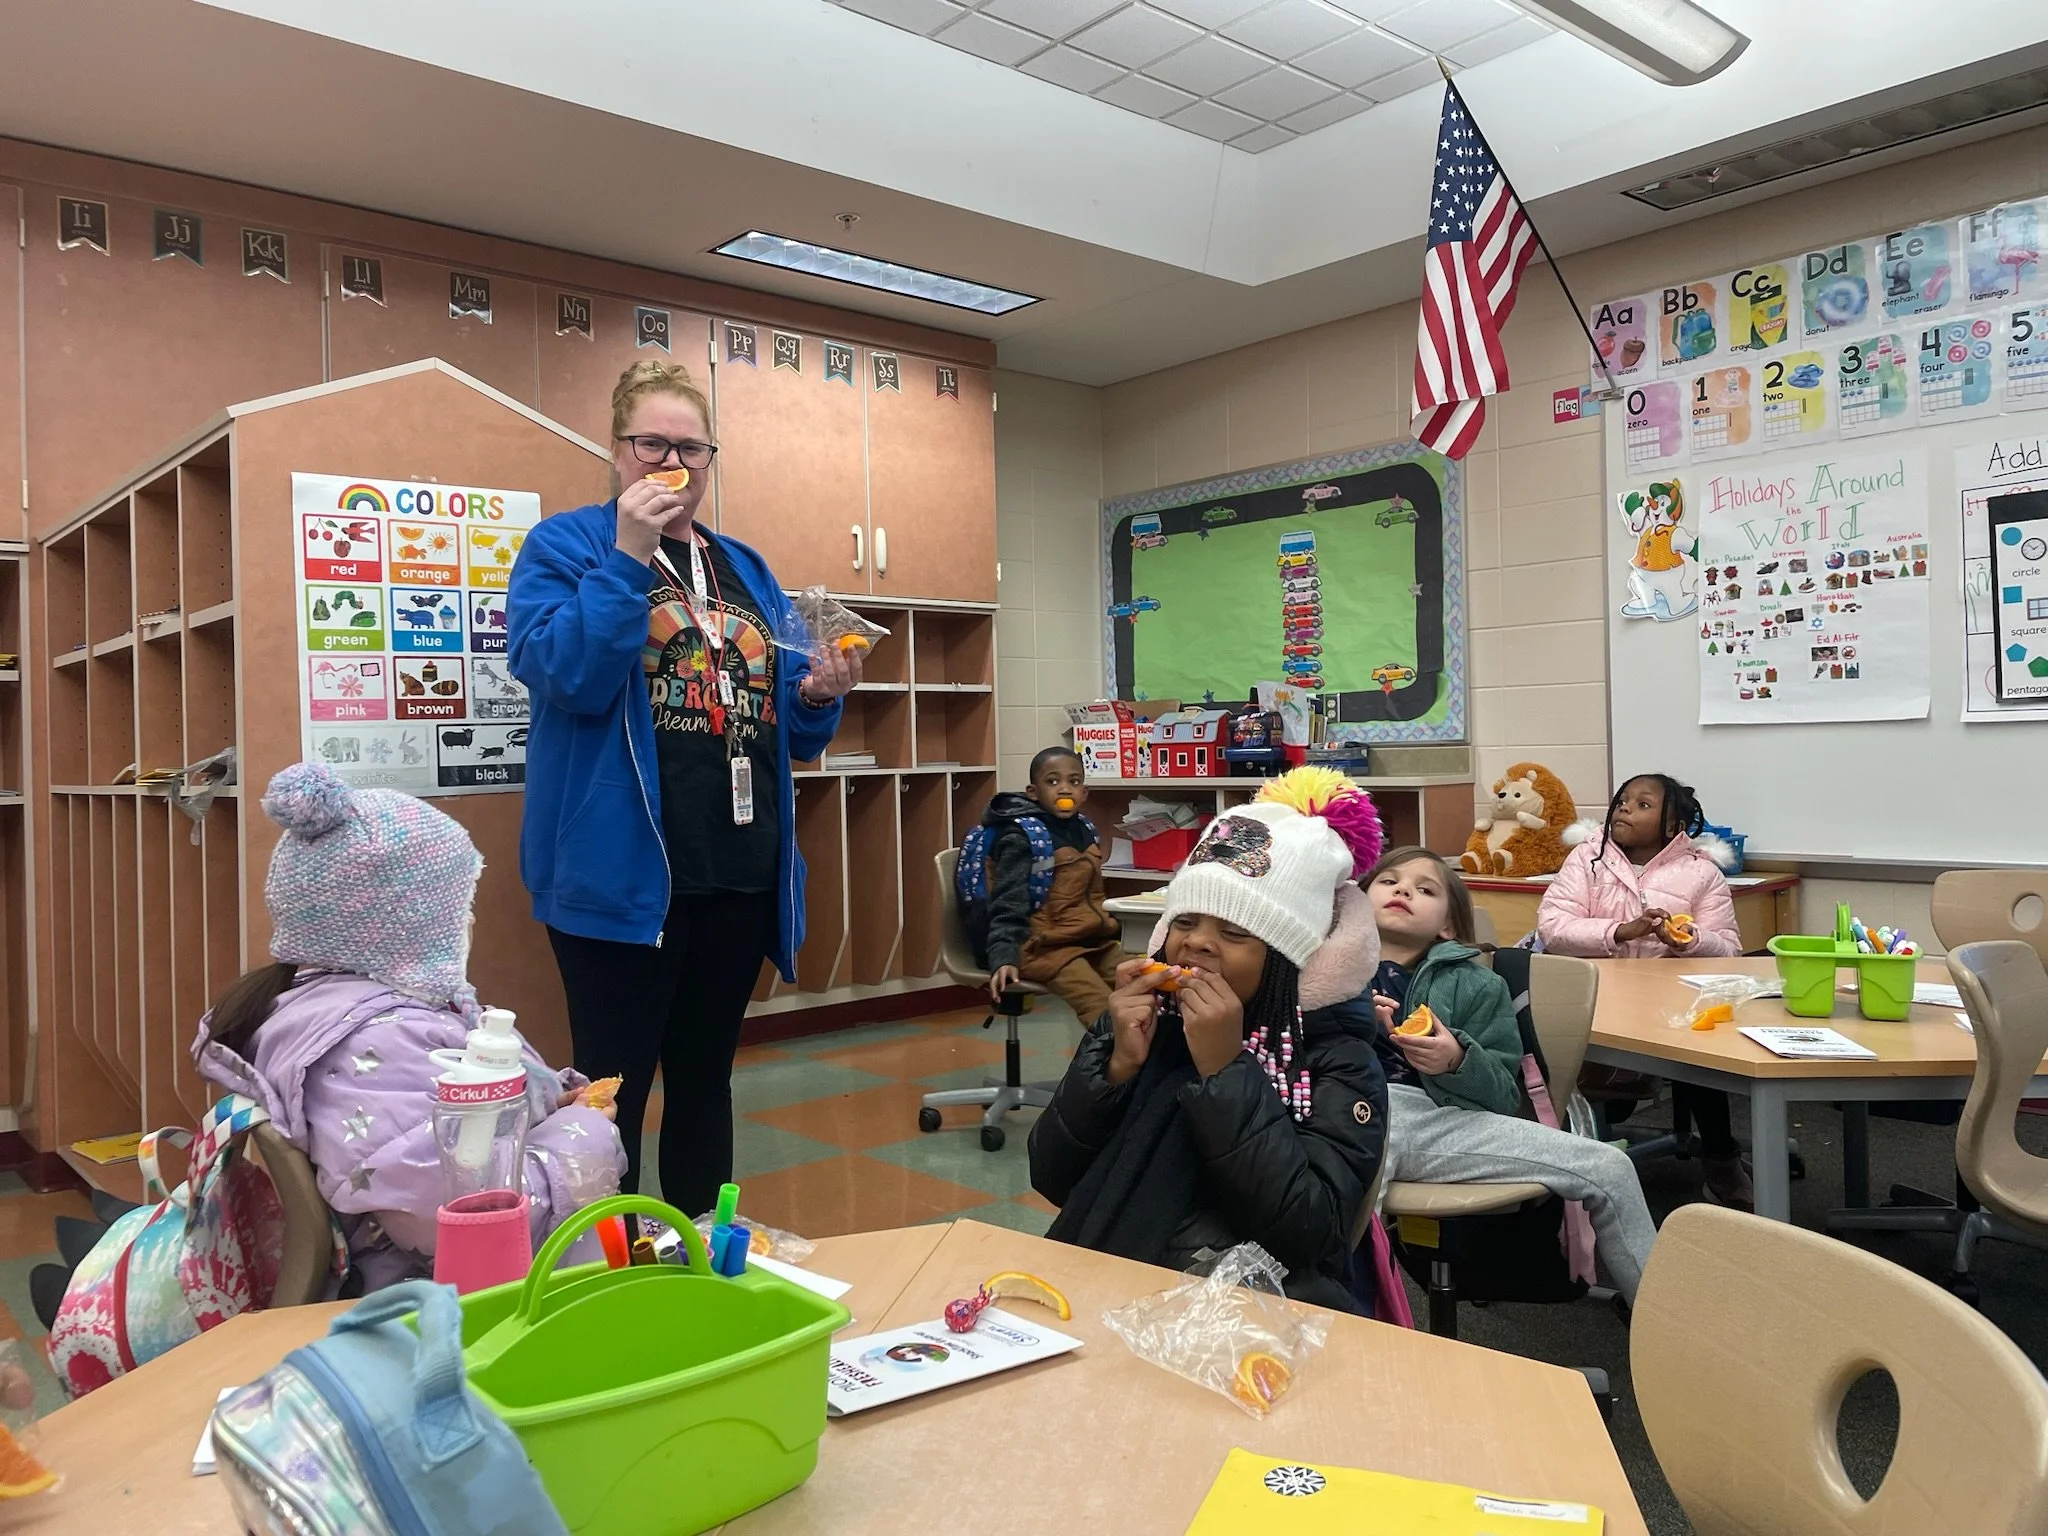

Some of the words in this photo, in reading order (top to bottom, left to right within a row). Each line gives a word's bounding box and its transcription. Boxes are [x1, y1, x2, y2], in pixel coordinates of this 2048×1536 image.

[72, 202, 91, 227] Ii
[164, 216, 191, 243] Jj
[1970, 208, 2003, 243] Ff
[246, 232, 282, 263] Kk
[1886, 232, 1924, 262] Ee
[353, 258, 370, 284] Ll
[1806, 246, 1848, 280] Dd
[453, 277, 487, 303] Mm
[1731, 270, 1771, 297] Cc
[1662, 286, 1698, 315] Bb
[1881, 292, 1920, 308] elephant
[1969, 287, 2009, 302] flamingo
[564, 299, 587, 322] Nn
[1594, 304, 1633, 329] Aa
[1914, 303, 1943, 315] eraser
[642, 314, 666, 333] Oo
[1805, 325, 1830, 336] donut
[2011, 311, 2033, 342] 5
[731, 329, 752, 351] Pp
[776, 336, 797, 360] Qq
[1921, 328, 1942, 358] 4
[829, 348, 850, 368] Rr
[2007, 344, 2029, 358] five
[879, 358, 894, 378] Ss
[1592, 360, 1611, 369] aple
[1662, 355, 1697, 367] backpack
[1840, 346, 1862, 374] 3
[1920, 361, 1945, 374] four
[939, 368, 955, 387] Tt
[1617, 367, 1638, 376] acorn
[1764, 361, 1784, 389] 2
[1695, 376, 1707, 402] 1
[1839, 375, 1870, 389] three
[1627, 390, 1646, 415] 0
[1762, 391, 1784, 403] two
[1556, 399, 1579, 415] flag
[1692, 406, 1710, 416] one
[1627, 418, 1648, 428] zero
[1987, 440, 2042, 471] Add
[1708, 475, 1796, 513] Holidays
[1805, 460, 1905, 504] Around
[396, 488, 504, 520] COLORS
[1786, 506, 1803, 516] the
[1737, 502, 1865, 550] World
[1886, 533, 1923, 544] Australia
[330, 563, 357, 576] red
[400, 569, 450, 583] orange
[2012, 566, 2041, 577] circle
[1816, 592, 1855, 602] Hanukkah
[715, 602, 757, 625] WATCH
[2011, 626, 2047, 638] square
[324, 635, 368, 649] green
[413, 634, 442, 647] blue
[483, 638, 508, 650] pur
[335, 704, 367, 718] pink
[407, 702, 454, 715] brown
[491, 704, 524, 717] gray
[1077, 727, 1116, 741] HUGGIES
[352, 772, 395, 786] white
[475, 768, 509, 781] black
[449, 1086, 489, 1101] Cirkul
